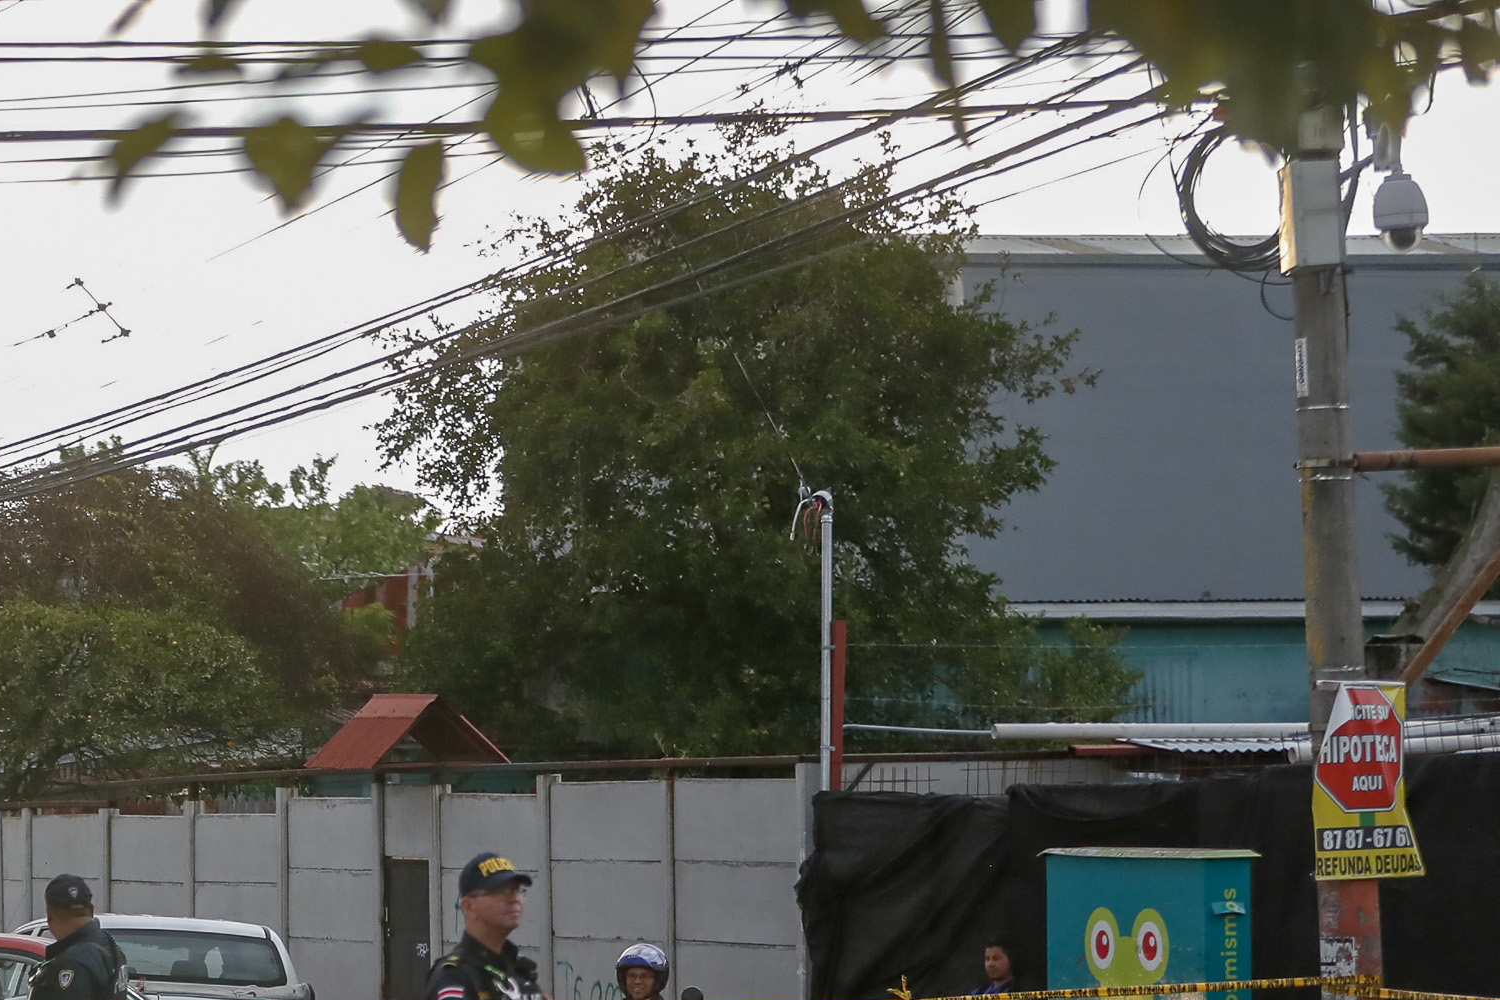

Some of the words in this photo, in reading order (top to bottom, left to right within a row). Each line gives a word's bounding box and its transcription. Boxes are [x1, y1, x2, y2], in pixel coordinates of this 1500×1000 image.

[1377, 704, 1389, 720] SU
[1320, 734, 1399, 764] HIPOTECA
[1352, 775, 1384, 792] AQUI
[1316, 855, 1372, 877] REFUNDA
